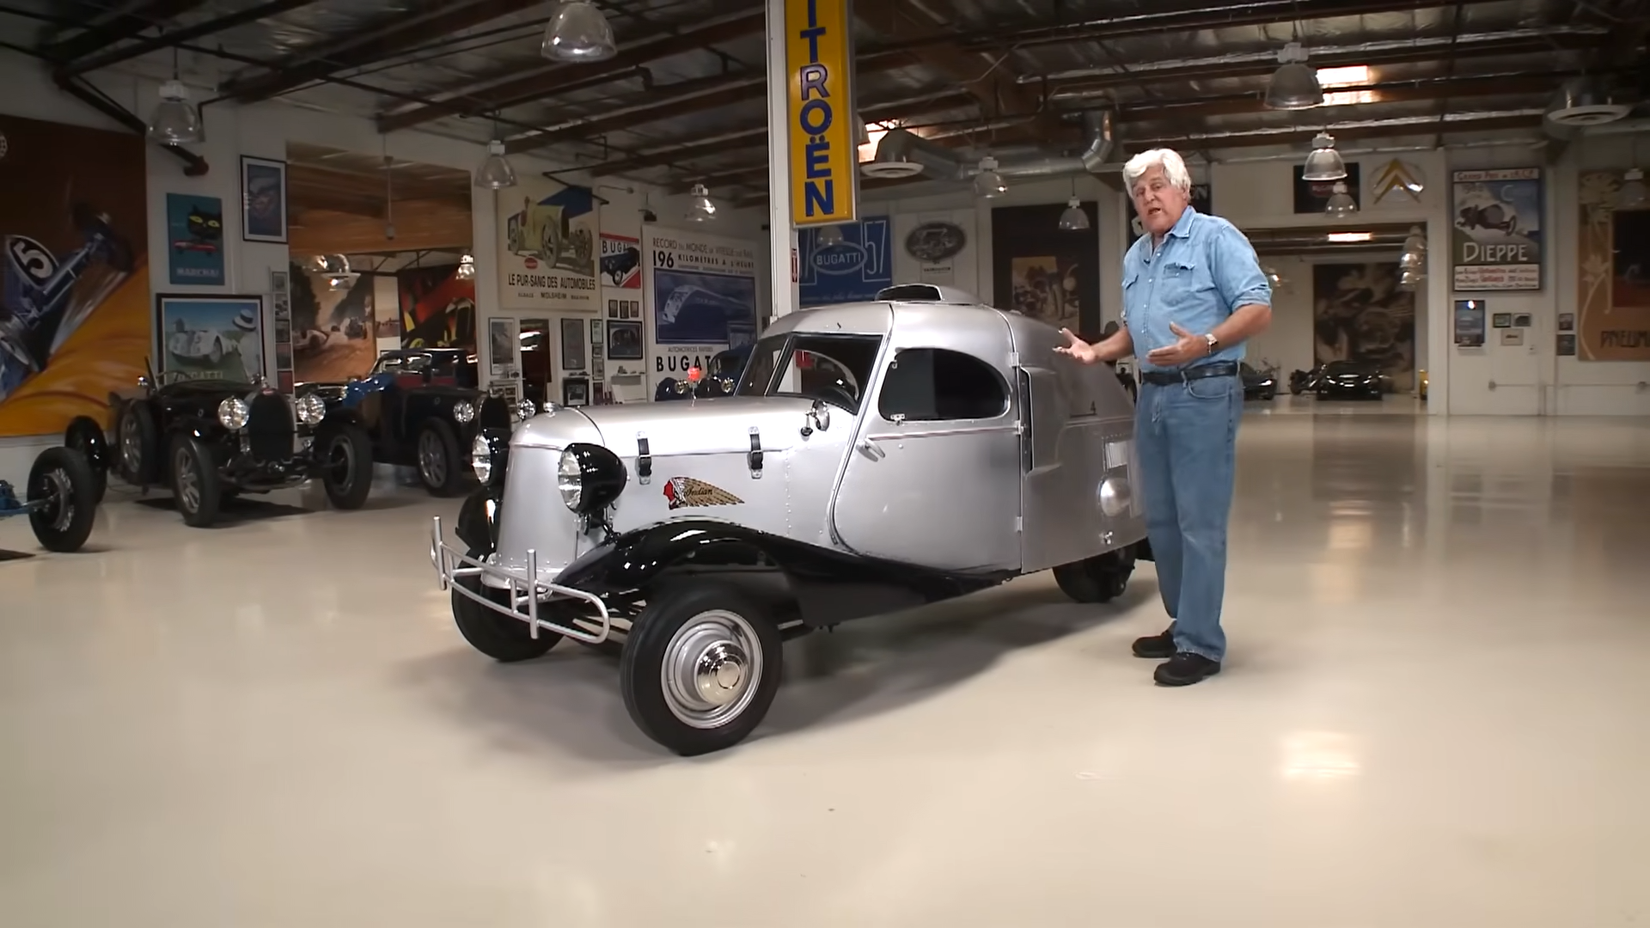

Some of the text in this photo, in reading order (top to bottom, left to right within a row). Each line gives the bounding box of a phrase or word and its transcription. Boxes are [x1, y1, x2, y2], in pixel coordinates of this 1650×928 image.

[653, 237, 677, 250] RECORD
[653, 249, 675, 269] 196
[816, 252, 861, 266] BUGATTI
[1463, 242, 1528, 262] DIEPPE
[508, 273, 596, 291] LE PUR-SANG DES AUTOMOBILES
[684, 487, 713, 497] Indian
